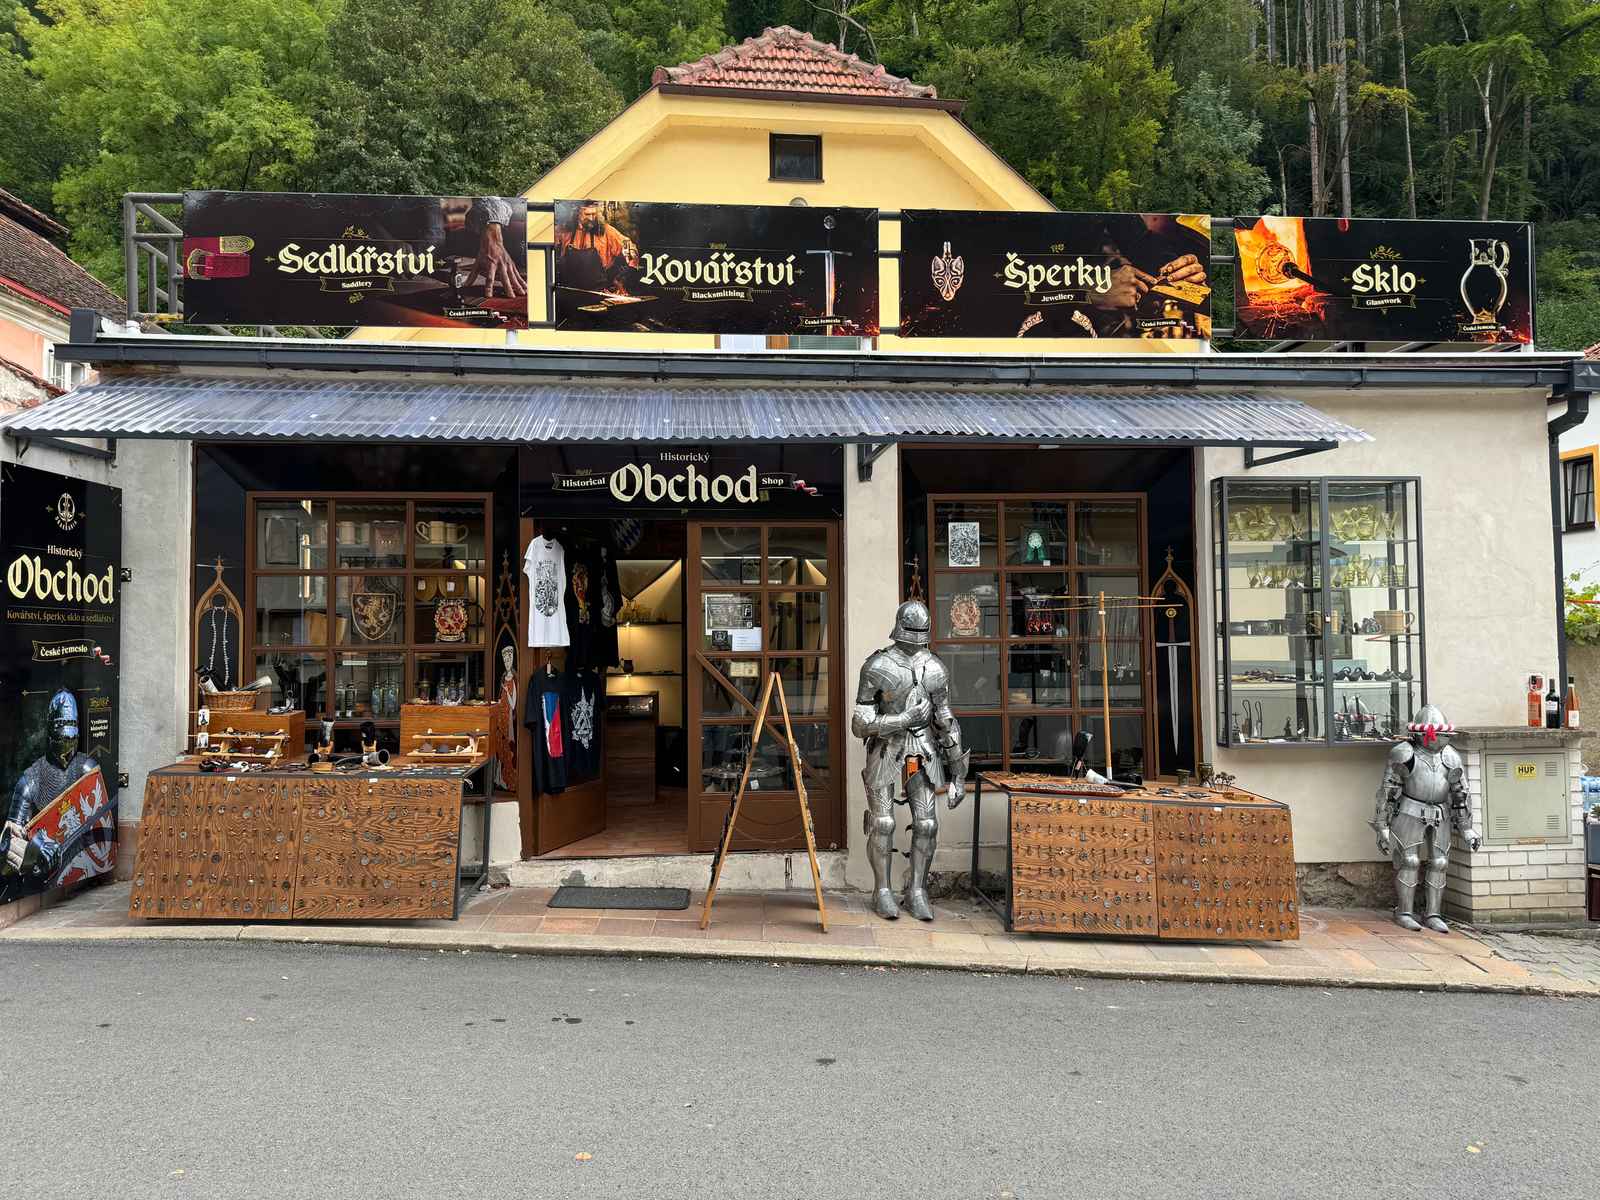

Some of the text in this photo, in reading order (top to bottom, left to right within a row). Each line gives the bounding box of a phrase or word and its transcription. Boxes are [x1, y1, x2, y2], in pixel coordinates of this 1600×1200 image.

[277, 243, 435, 274] Sedlářství
[640, 252, 796, 286] Kovářství
[1003, 251, 1113, 293] Šperky
[1352, 263, 1416, 293] Sklo
[341, 279, 373, 290] Saddlery
[691, 289, 746, 301] Blacksmithing
[1040, 292, 1075, 302] Jewellery
[1366, 297, 1402, 306] Glasswork
[660, 451, 710, 464] Historický
[562, 476, 606, 488] Historical
[609, 462, 759, 503] Obchod
[761, 476, 784, 487] Shop
[47, 544, 83, 560] Historický
[7, 554, 114, 604] Obchod
[40, 644, 88, 656] České řemeslo
[1518, 766, 1535, 774] HUP
